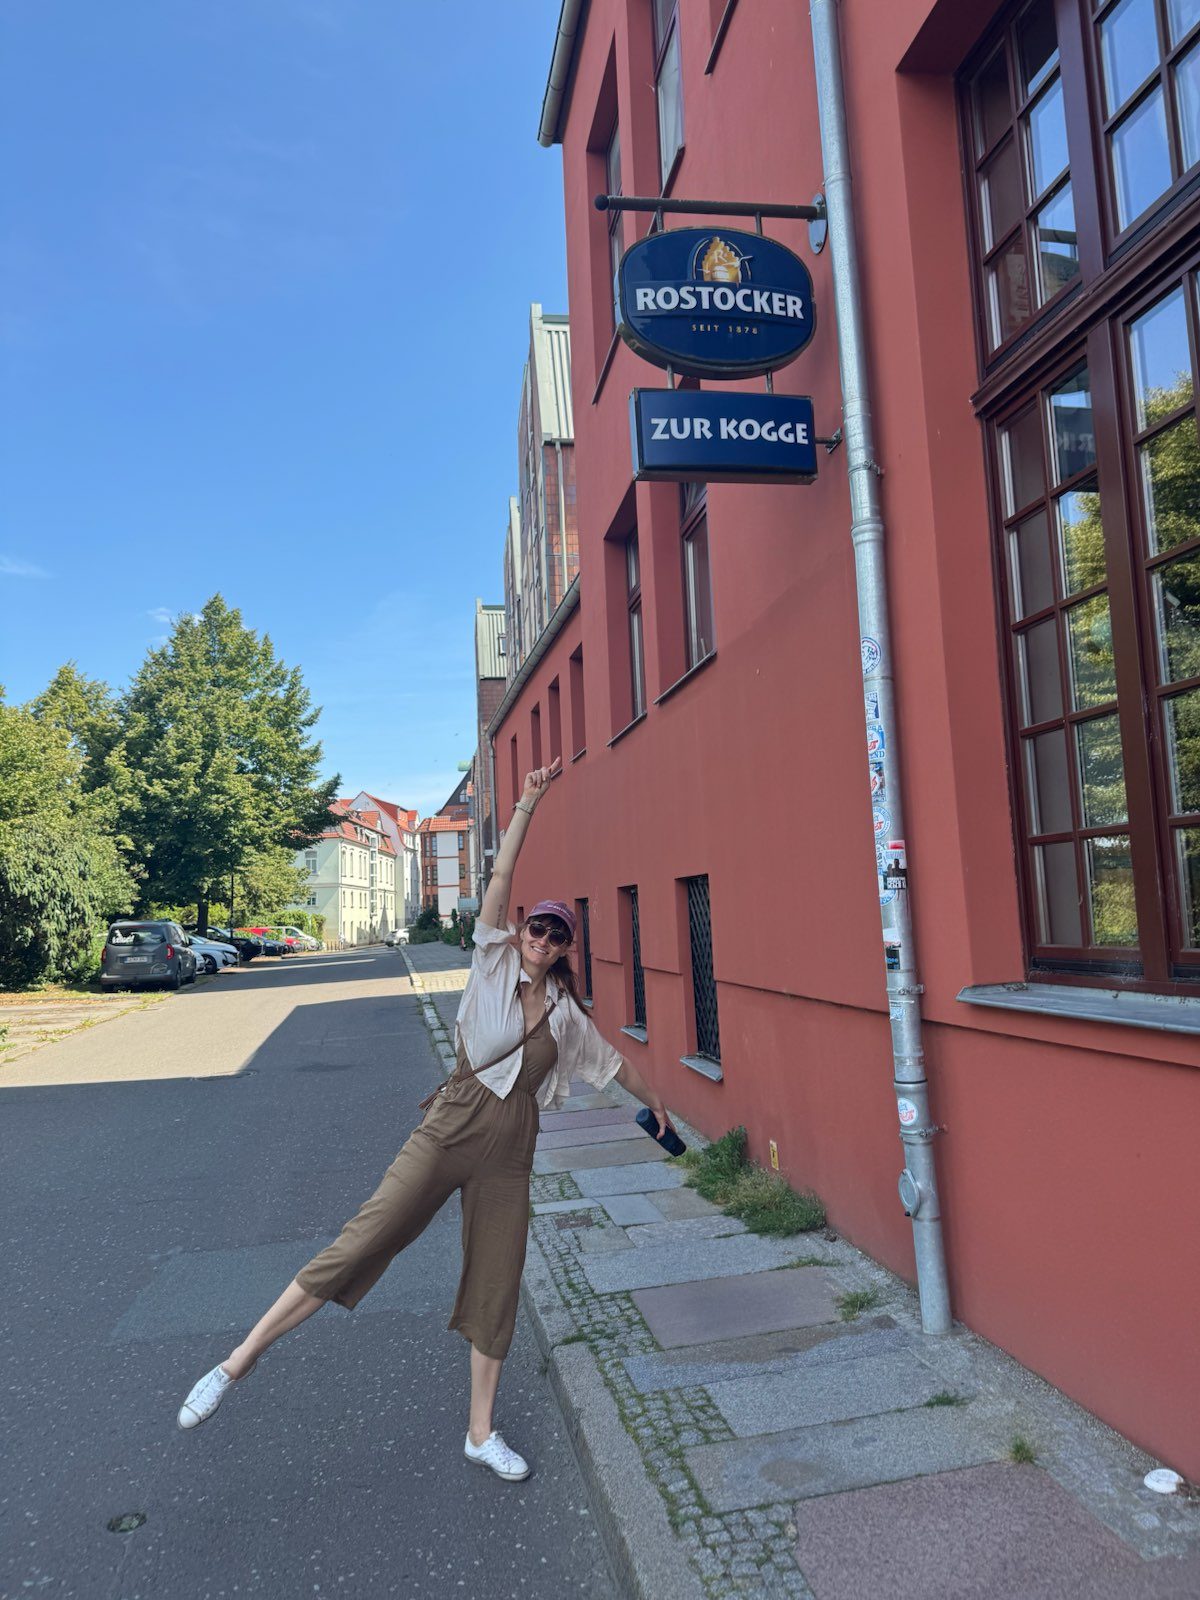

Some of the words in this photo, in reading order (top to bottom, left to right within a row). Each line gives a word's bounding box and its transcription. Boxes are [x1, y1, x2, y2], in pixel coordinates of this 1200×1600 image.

[635, 285, 805, 320] ROSTOCKER
[691, 324, 720, 332] SEIT
[727, 325, 758, 335] 1878
[650, 417, 714, 441] ZUR
[718, 417, 809, 445] KOGGE
